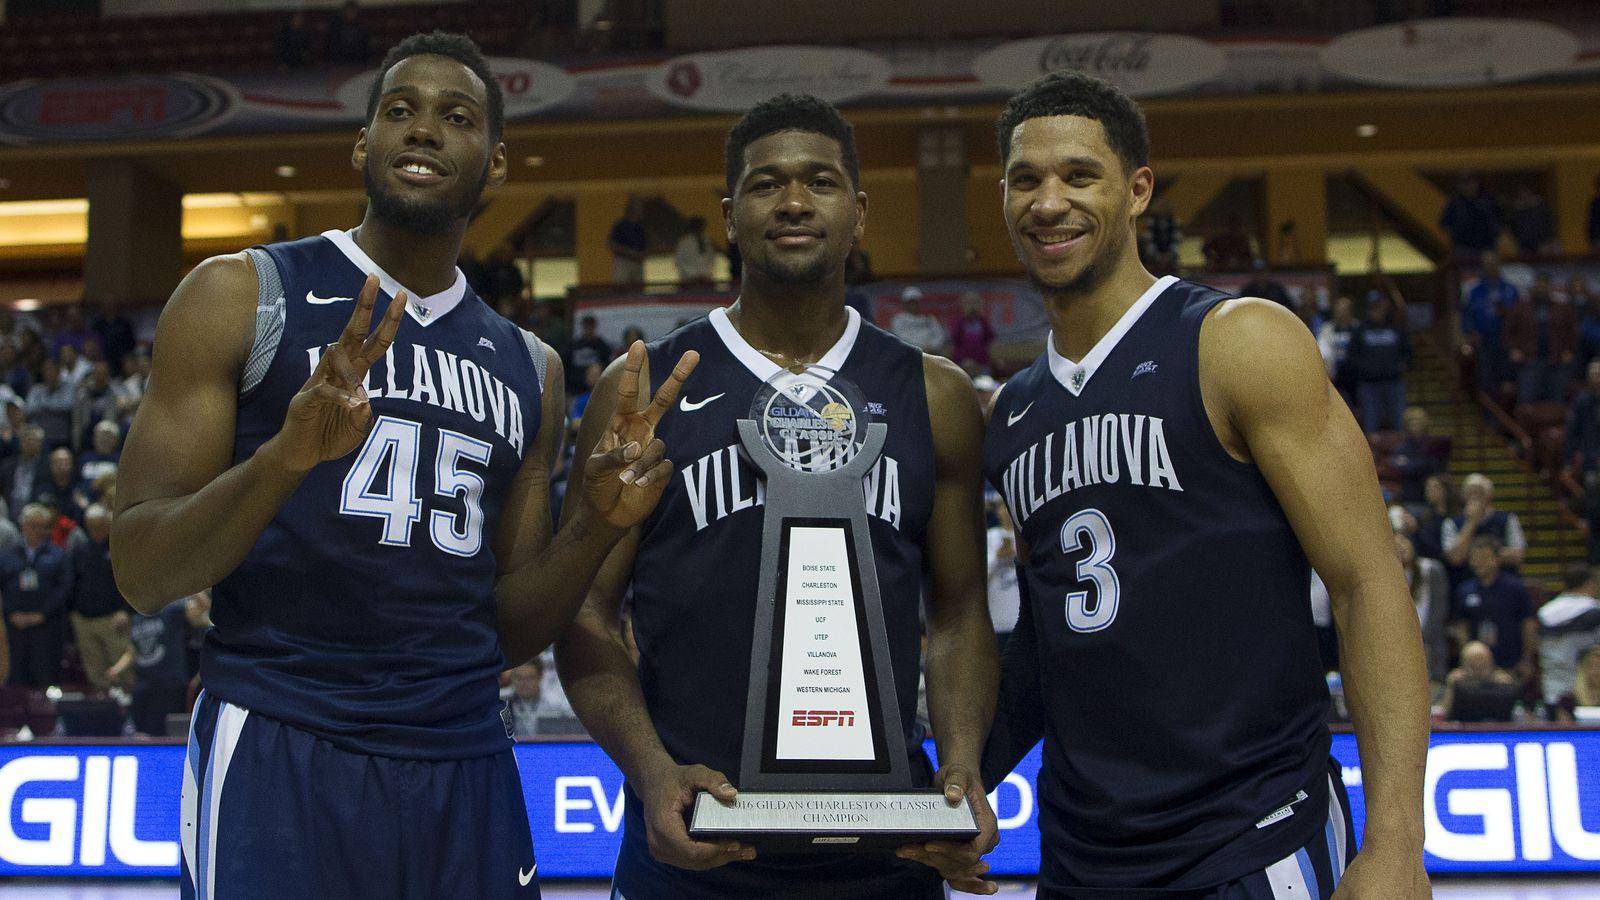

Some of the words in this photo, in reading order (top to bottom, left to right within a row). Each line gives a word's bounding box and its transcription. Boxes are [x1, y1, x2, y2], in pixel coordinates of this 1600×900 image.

[305, 340, 524, 460] LLANOVA
[339, 416, 493, 558] 45
[1003, 413, 1184, 534] VILLANOVA
[1060, 508, 1120, 633] 3
[792, 710, 855, 727] ESPN
[732, 800, 754, 811] 016
[756, 800, 803, 811] GILDAN
[806, 800, 888, 811] CHARLESTON
[890, 800, 940, 811] CLASSIC
[803, 813, 870, 824] CHAMPION
